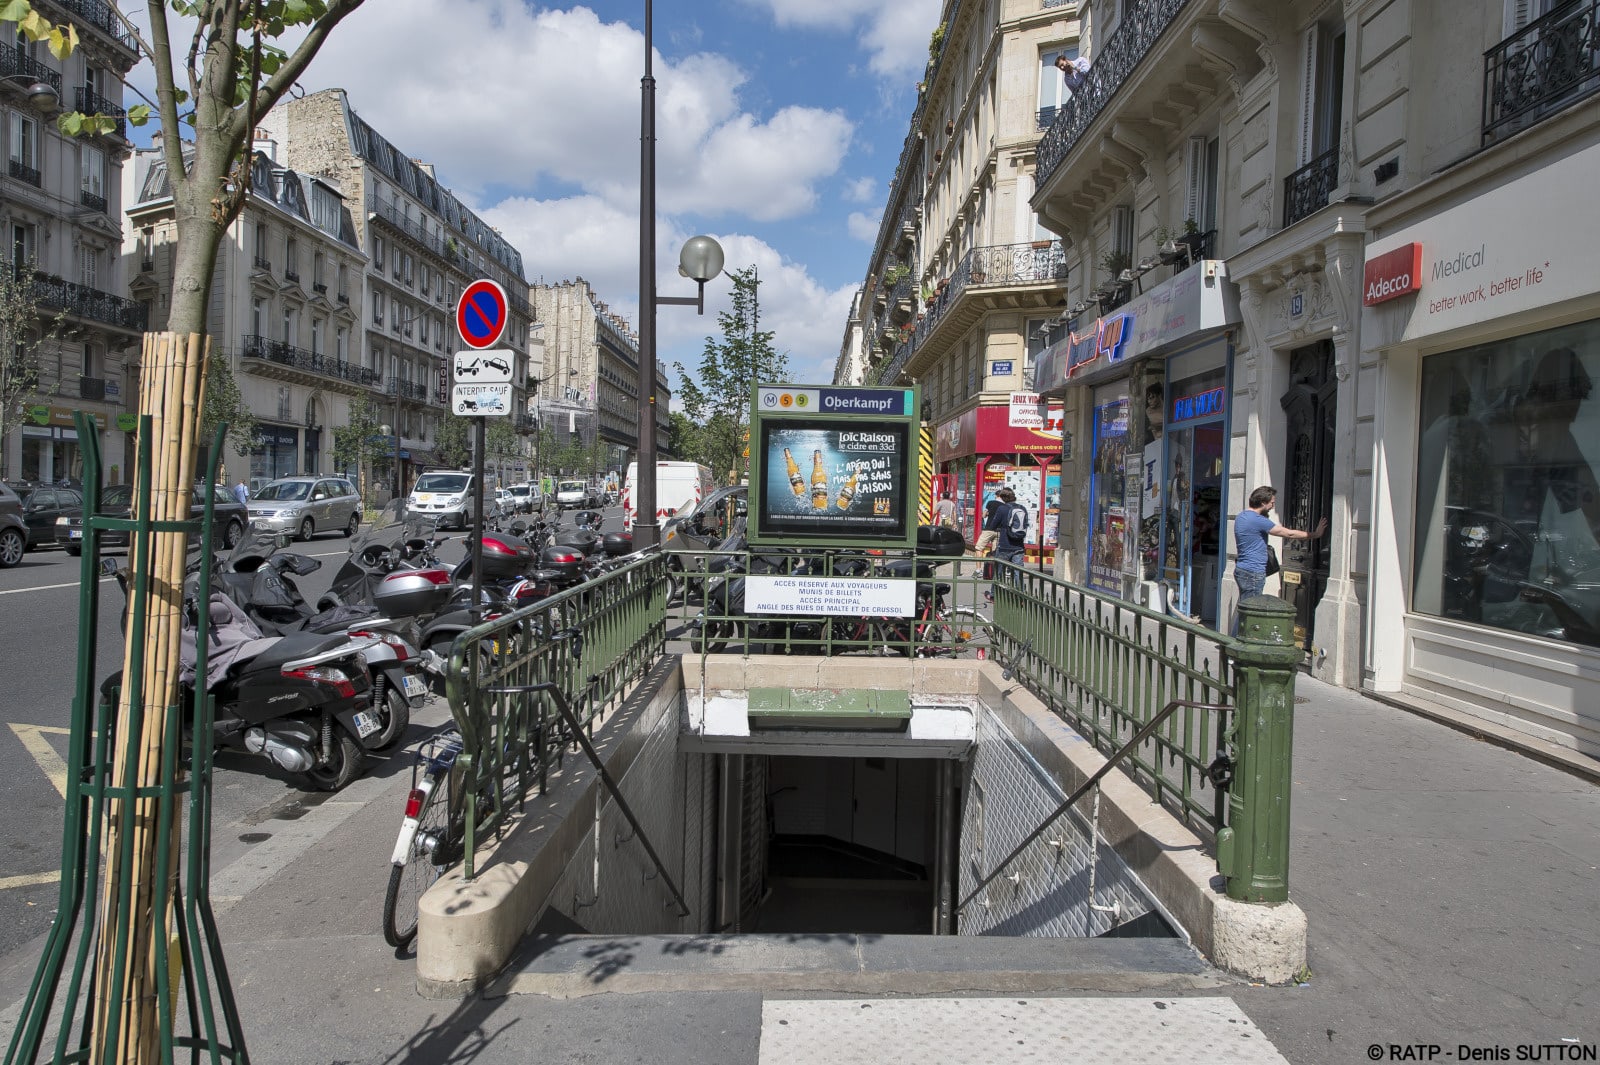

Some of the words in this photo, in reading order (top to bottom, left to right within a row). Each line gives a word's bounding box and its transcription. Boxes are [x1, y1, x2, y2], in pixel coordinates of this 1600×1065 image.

[1432, 244, 1486, 282] Medical
[1366, 273, 1410, 301] Adecco
[1430, 296, 1457, 314] better
[1460, 284, 1486, 306] work,
[1490, 276, 1522, 296] better
[1292, 297, 1301, 314] 19
[456, 386, 486, 396] INTERDIT
[490, 386, 508, 395] SAUF
[824, 396, 893, 411] Oberkampf
[1012, 395, 1026, 404] JEUX
[839, 432, 858, 442] Loïc
[860, 432, 895, 443] Raison
[856, 473, 868, 482] PAS
[871, 471, 892, 480] SANS
[856, 482, 892, 494] RAISON
